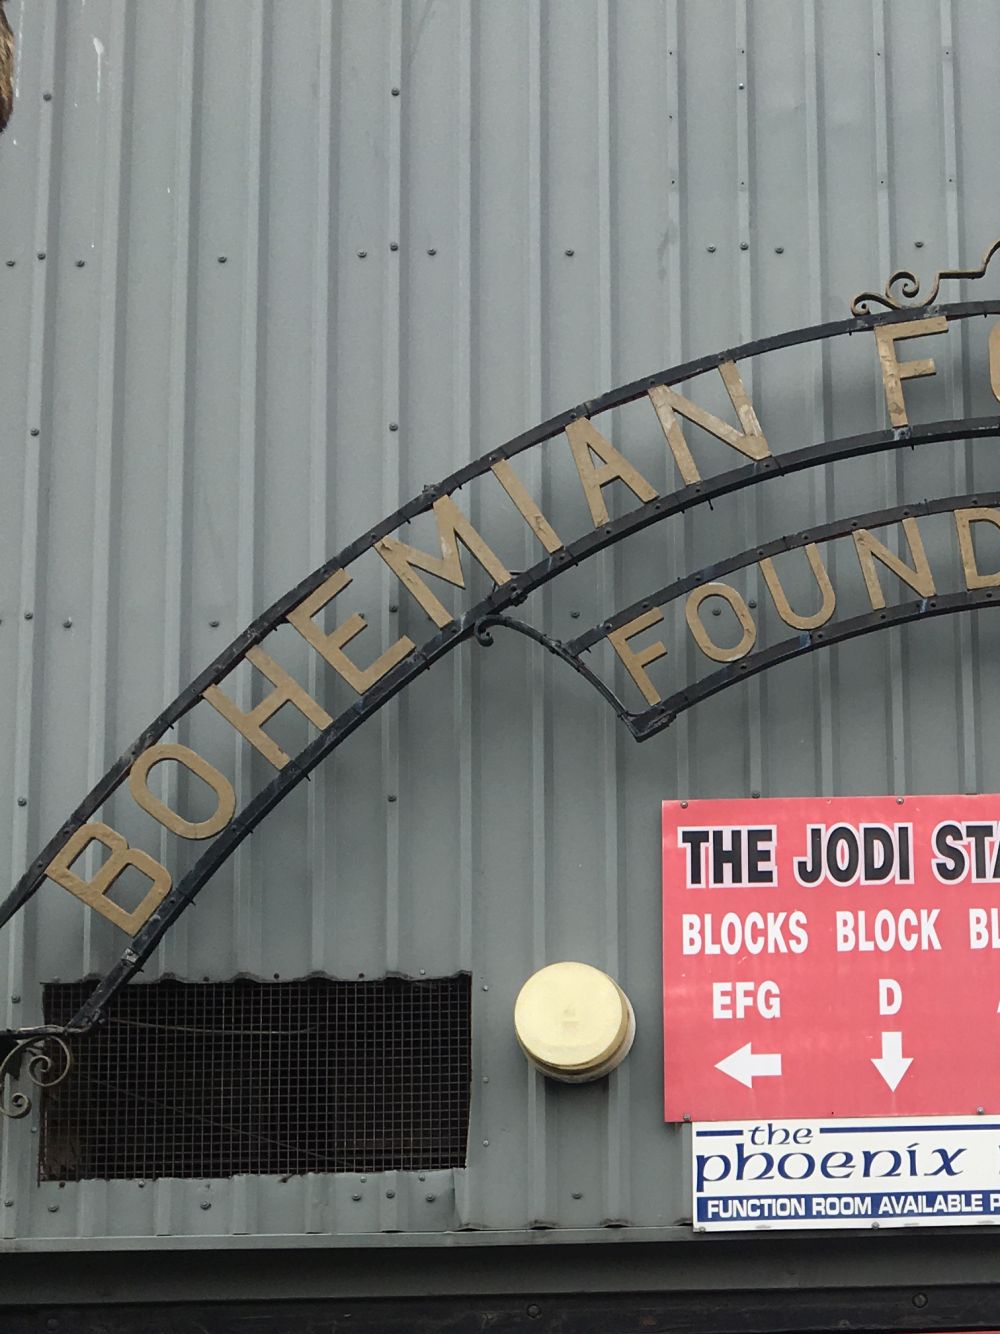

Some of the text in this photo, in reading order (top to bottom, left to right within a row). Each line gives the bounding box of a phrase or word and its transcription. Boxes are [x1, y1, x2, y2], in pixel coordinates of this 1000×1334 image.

[45, 361, 772, 936] BOHEMIAN
[677, 825, 777, 889] THE
[793, 822, 915, 888] JODI
[682, 911, 809, 955] BLOCKS
[836, 909, 942, 952] BLOCK
[712, 980, 781, 1019] EFG
[878, 979, 902, 1015] D
[748, 1123, 814, 1146] the
[707, 1197, 806, 1218] FUNCTION
[812, 1196, 872, 1216] ROOM
[878, 1194, 983, 1214] AVAILABLE
